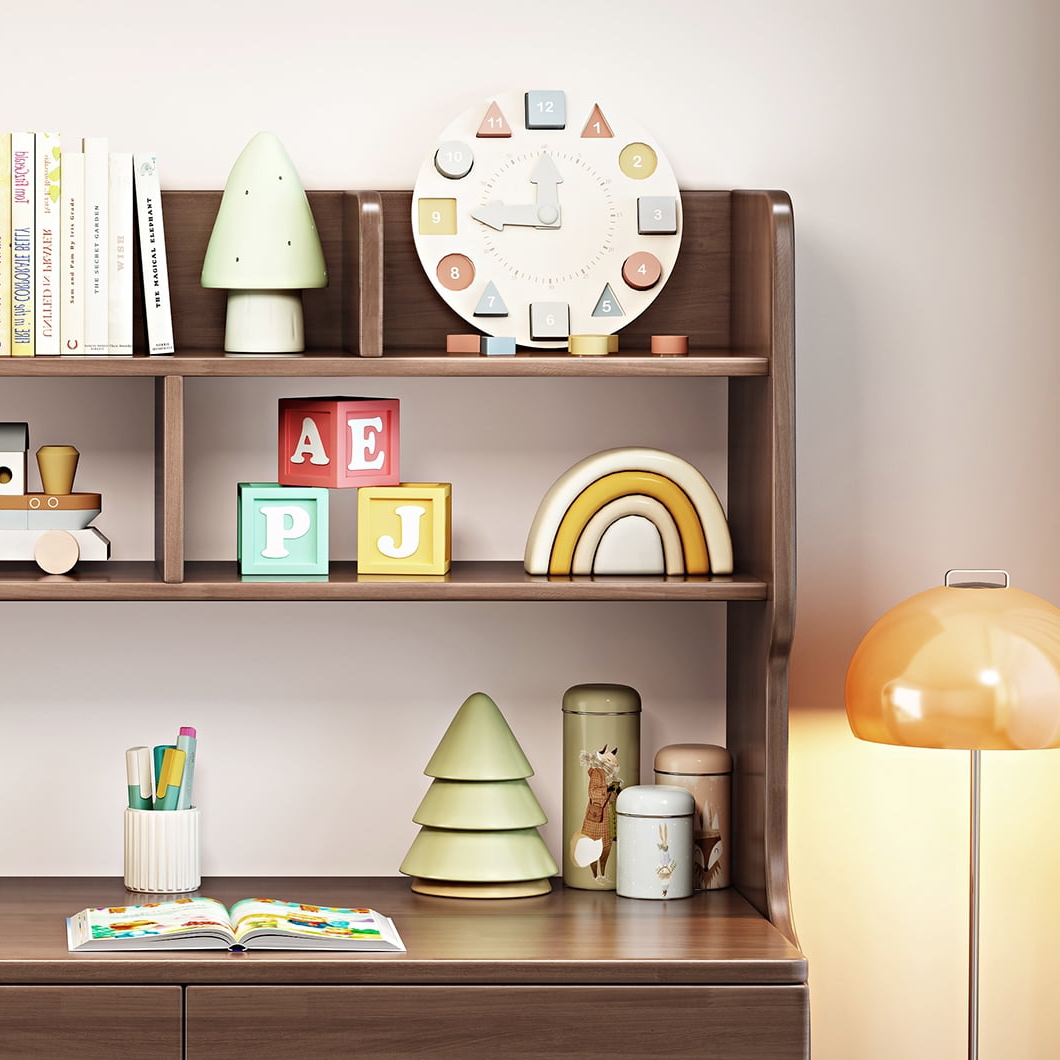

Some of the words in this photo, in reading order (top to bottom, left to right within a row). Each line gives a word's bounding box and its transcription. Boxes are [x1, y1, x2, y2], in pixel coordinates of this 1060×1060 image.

[537, 101, 554, 113] 12
[487, 117, 503, 129] 11
[593, 122, 602, 134] 1
[446, 151, 462, 162] 10
[633, 155, 642, 168] 2
[146, 198, 155, 243] ELEPHANT
[431, 211, 441, 224] 9
[654, 209, 662, 220] 3
[69, 241, 76, 250] By
[150, 248, 159, 287] MAGICAL
[450, 267, 460, 280] 8
[637, 264, 647, 275] 4
[487, 296, 496, 308] 7
[602, 301, 612, 312] 5
[546, 314, 555, 326] 6
[290, 417, 330, 466] A
[347, 417, 385, 471] E
[259, 506, 311, 559] P
[377, 505, 426, 559] J
